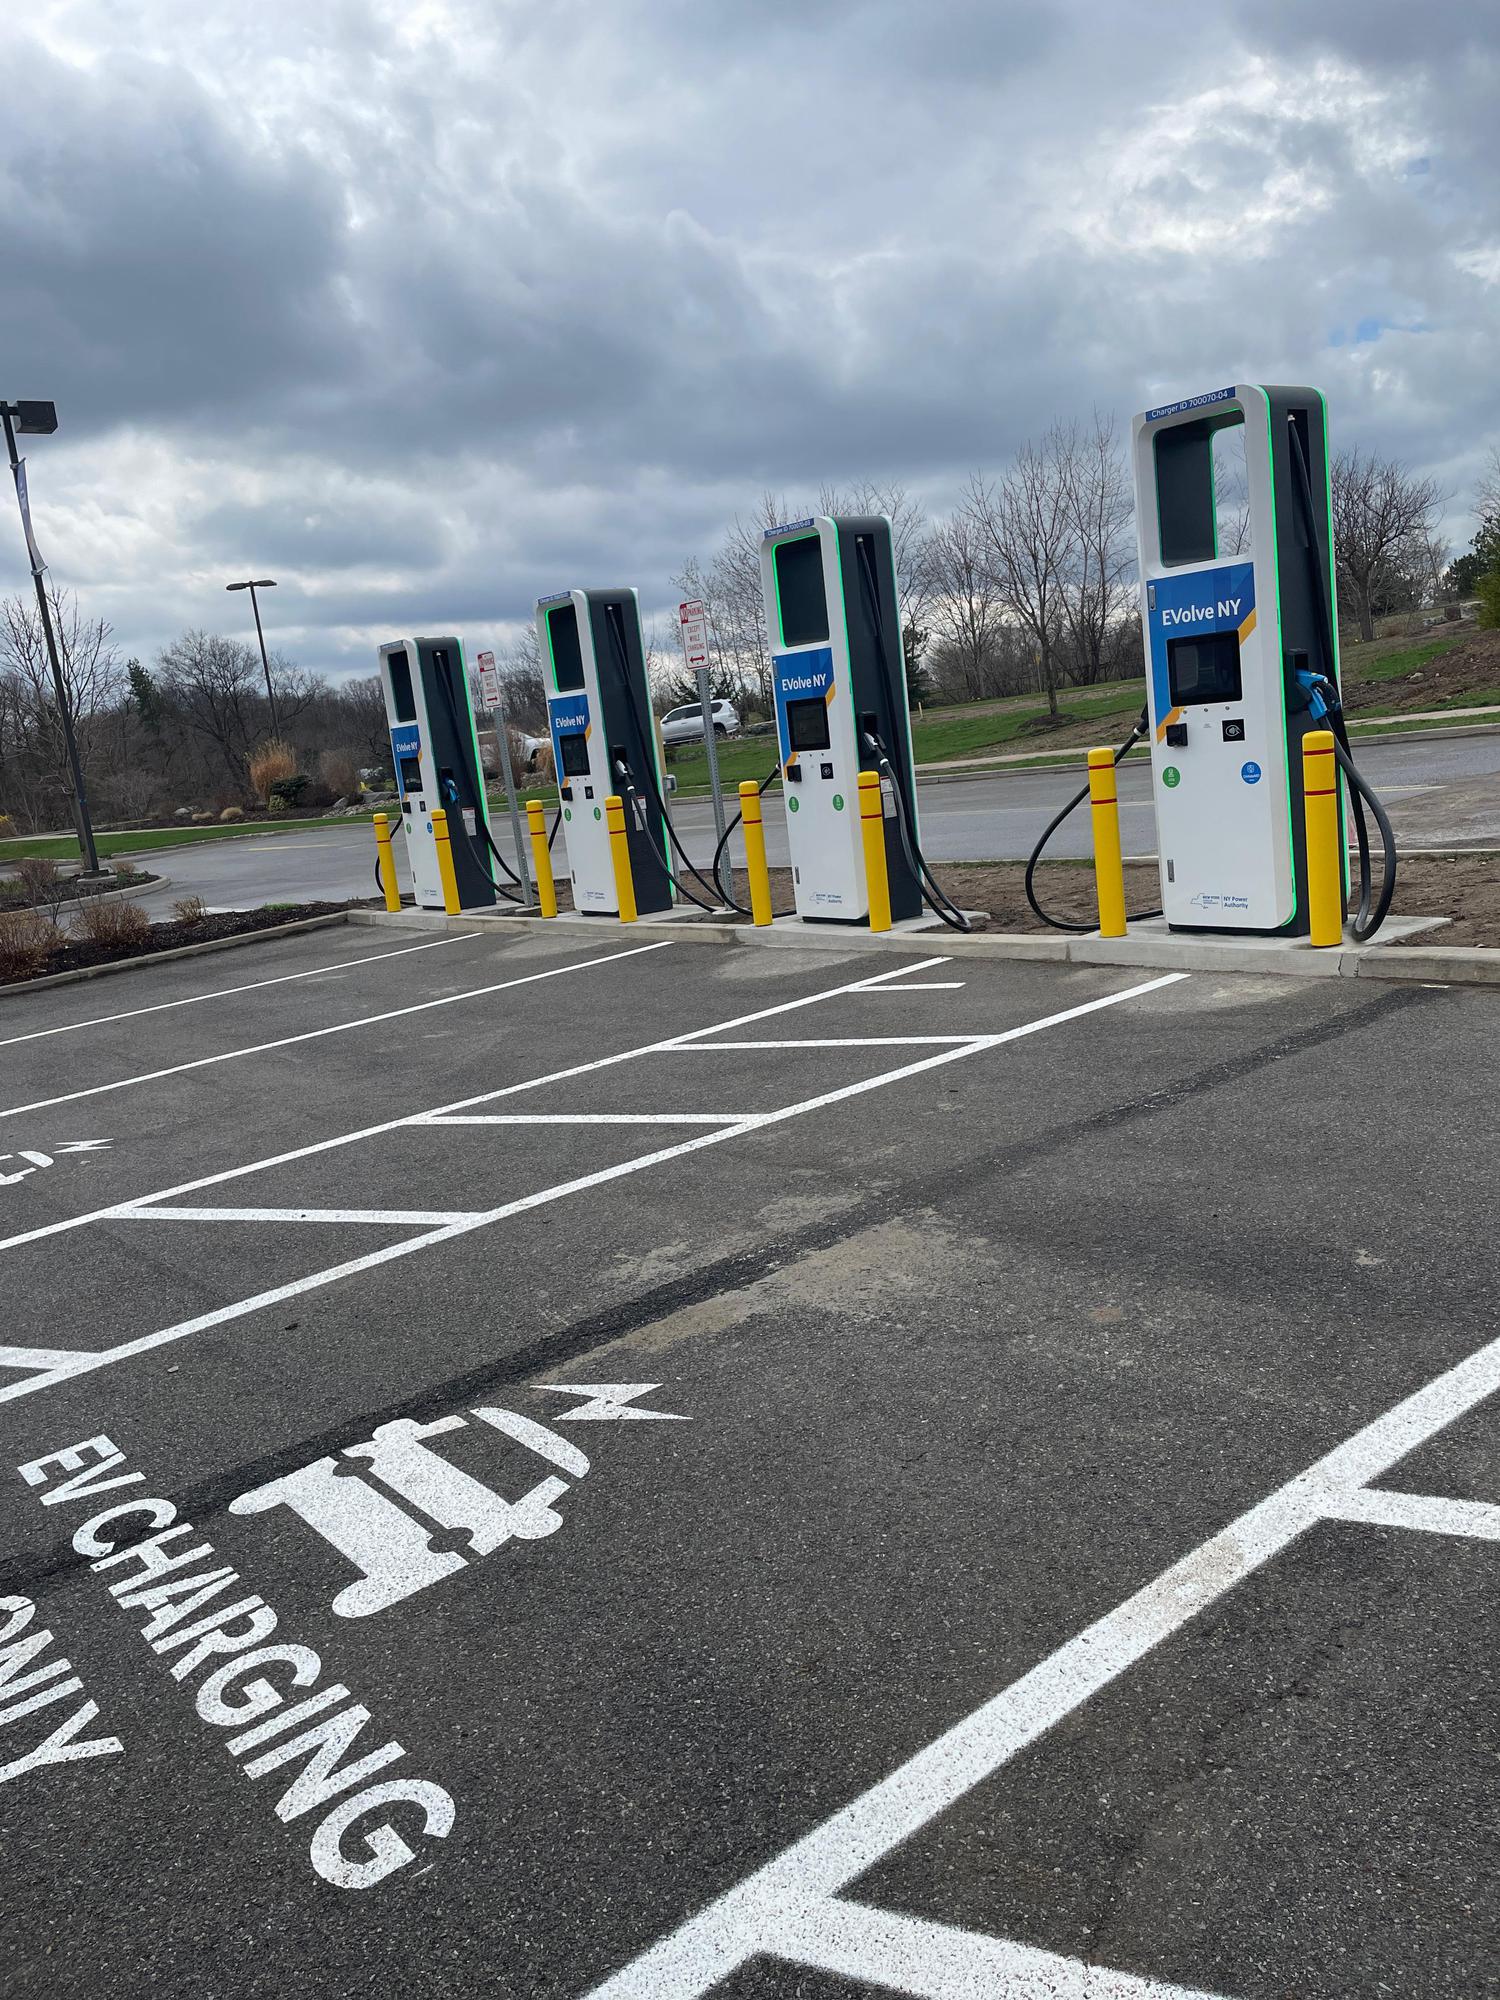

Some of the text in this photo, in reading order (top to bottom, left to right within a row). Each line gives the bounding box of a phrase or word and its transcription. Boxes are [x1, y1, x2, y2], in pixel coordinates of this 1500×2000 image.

[1151, 390, 1228, 418] Charger ID 700070-04
[1162, 598, 1242, 626] EVolve NY
[781, 673, 826, 691] EVolve NY
[555, 714, 585, 728] EVolve NY
[17, 1433, 456, 1890] EV CHARGING
